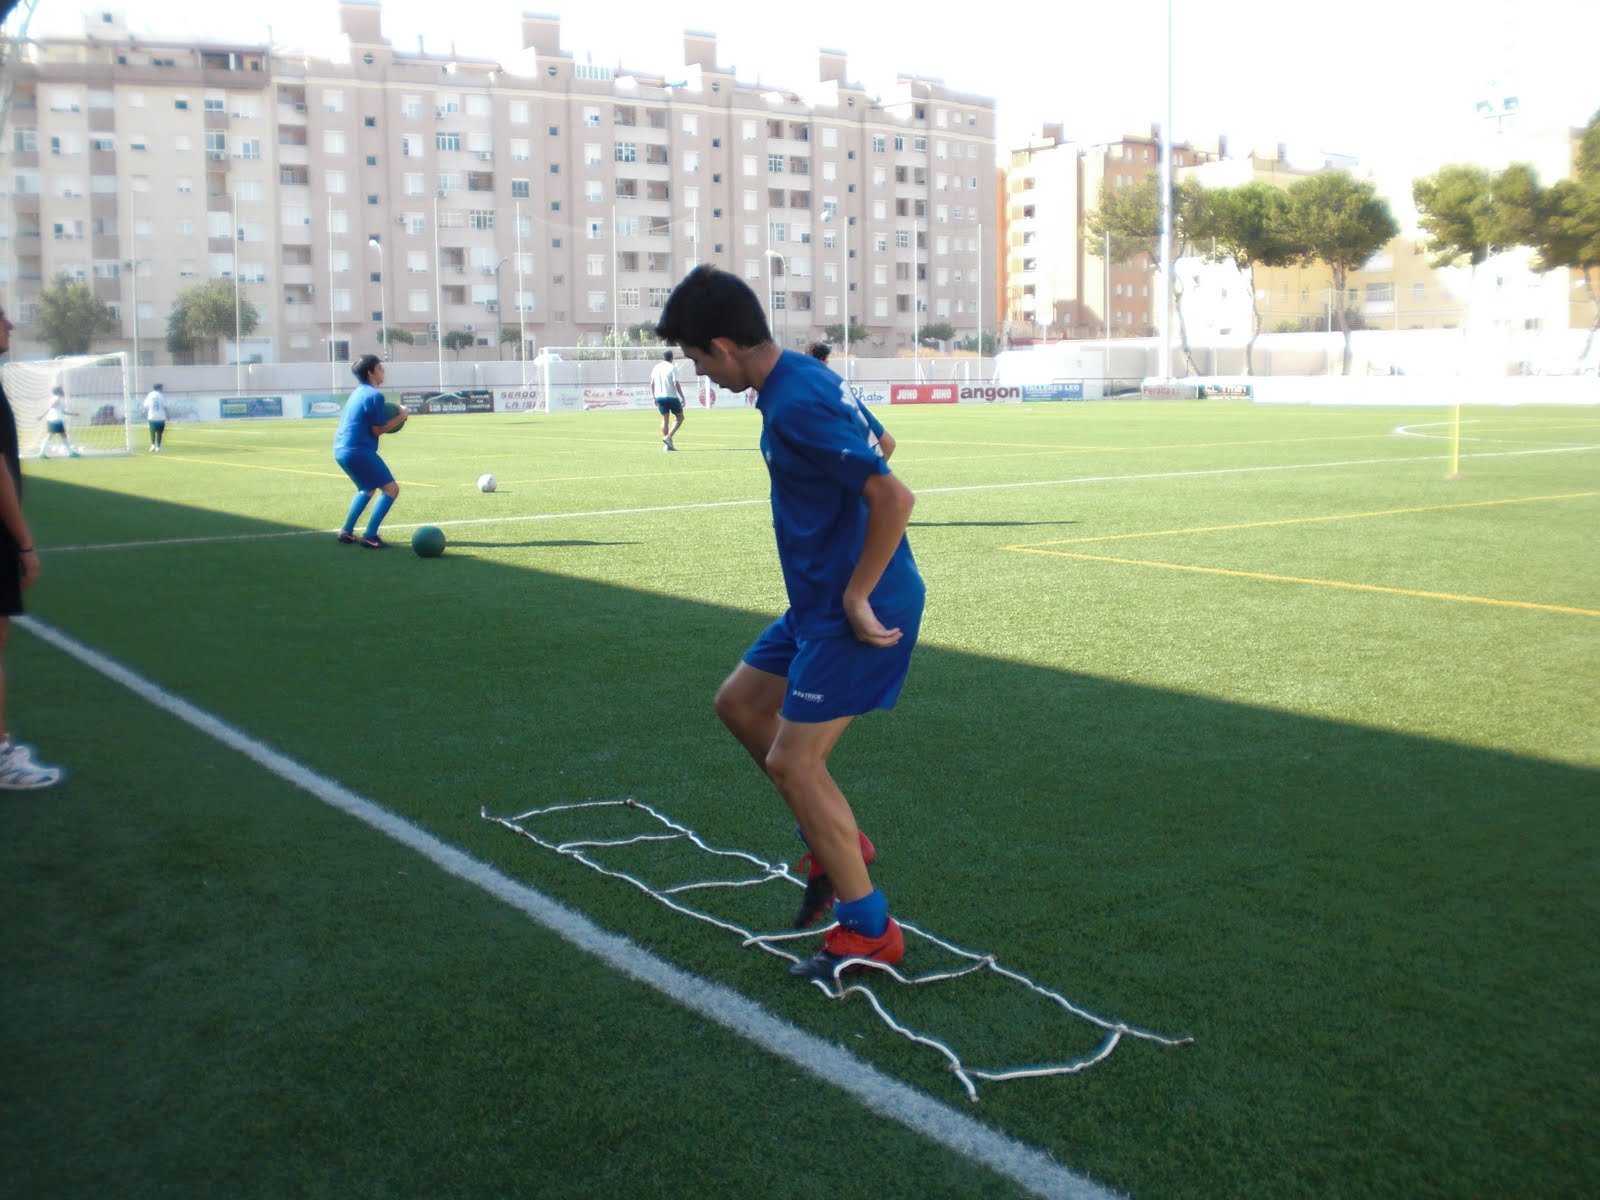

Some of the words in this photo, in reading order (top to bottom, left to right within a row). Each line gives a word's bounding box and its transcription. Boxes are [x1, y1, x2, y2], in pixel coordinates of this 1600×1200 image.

[960, 387, 1020, 401] angon
[1024, 384, 1063, 393] TALLERES
[896, 389, 918, 400] JUNO
